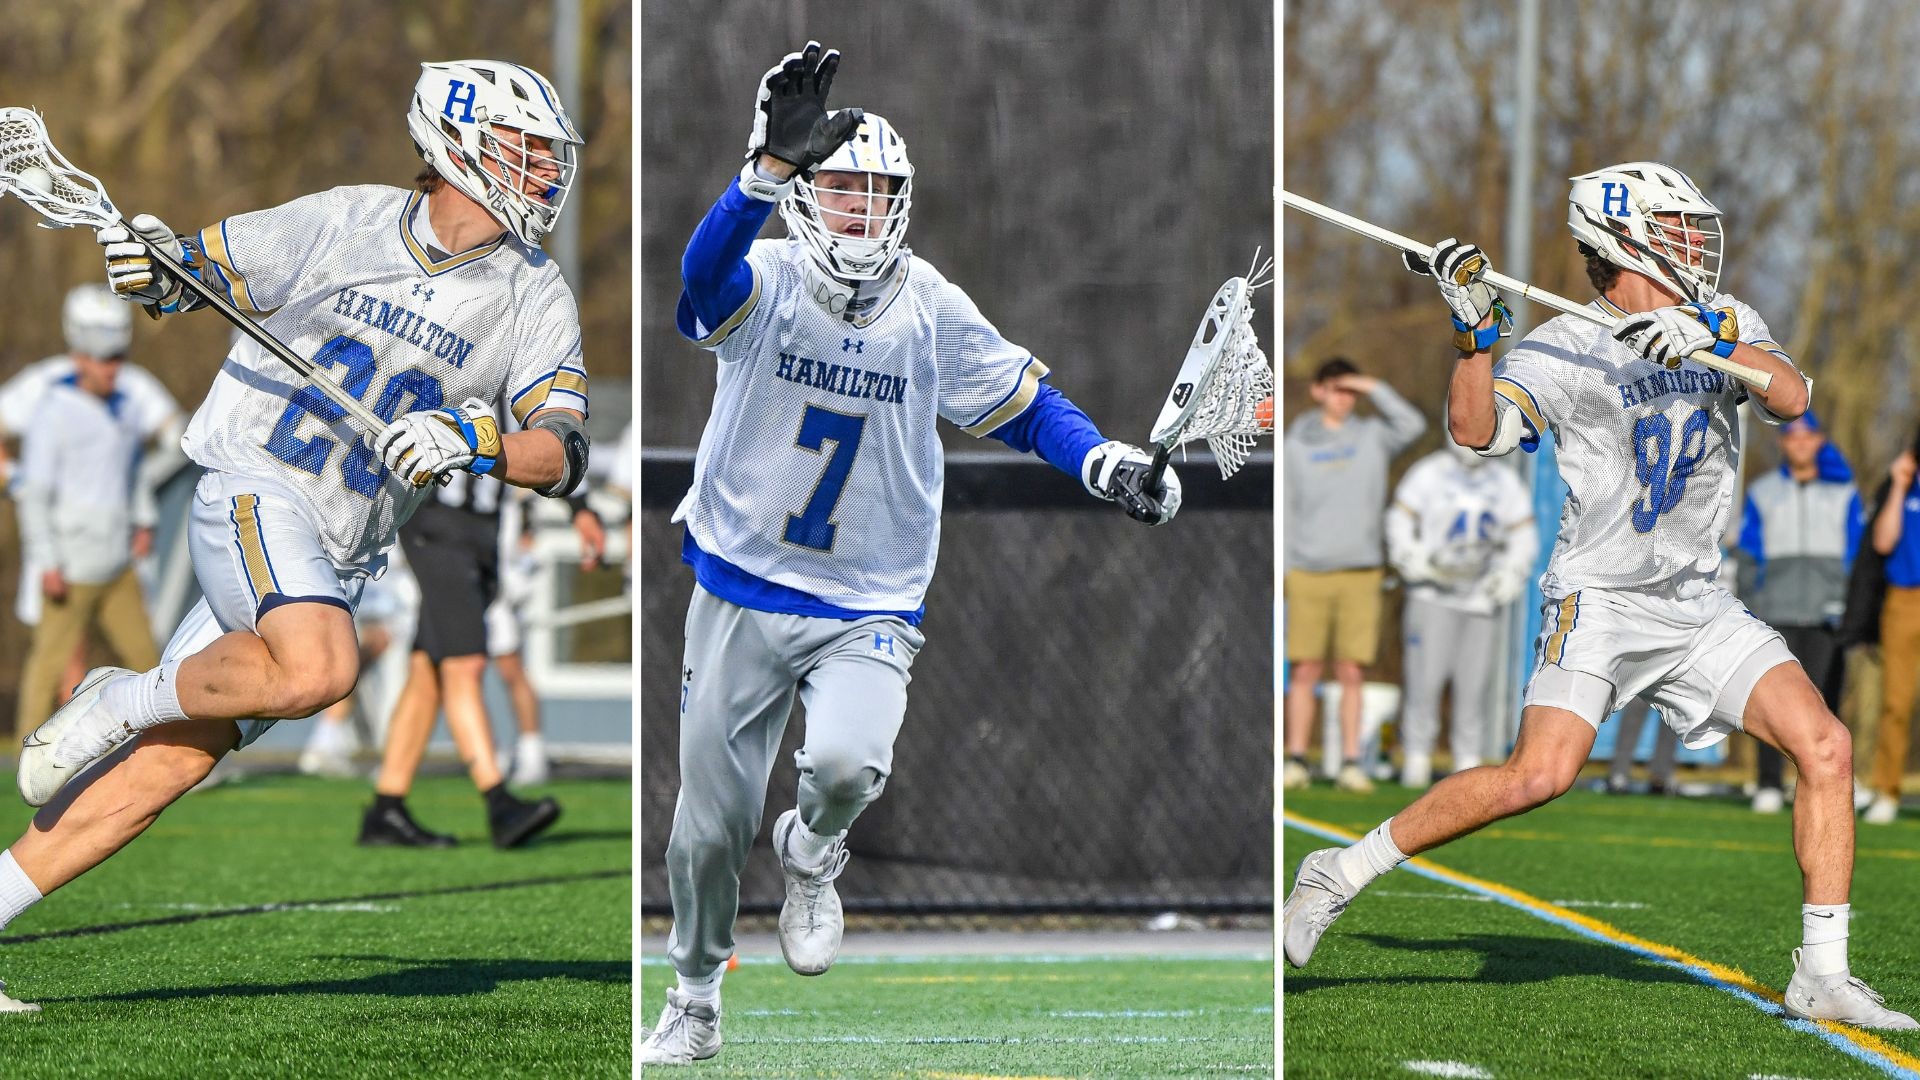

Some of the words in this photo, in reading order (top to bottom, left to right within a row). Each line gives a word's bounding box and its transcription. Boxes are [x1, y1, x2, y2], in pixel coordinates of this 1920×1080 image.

[441, 79, 476, 124] H
[1602, 182, 1631, 217] H
[333, 287, 475, 369] HAMILTON
[776, 352, 908, 404] HAMILTON
[1618, 369, 1725, 409] HAMILTON
[780, 401, 869, 554] 7
[873, 632, 895, 657] H
